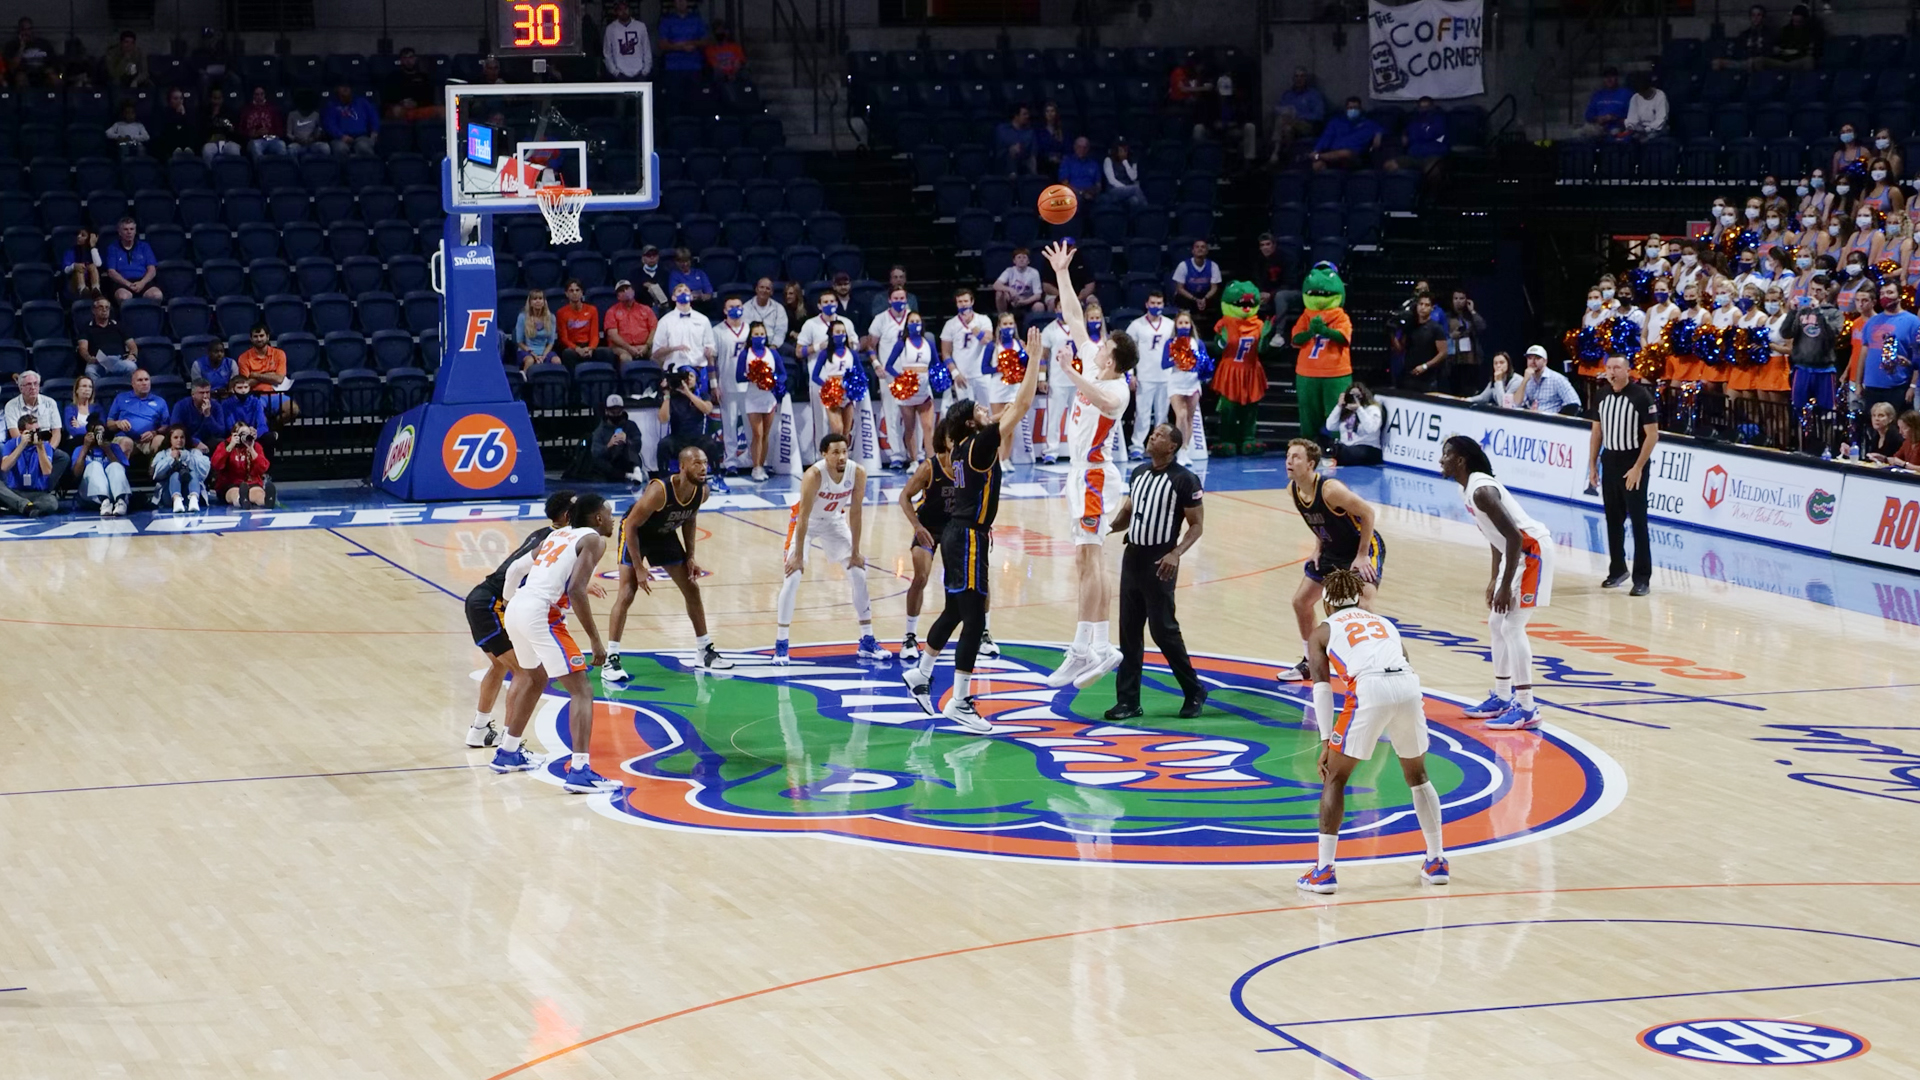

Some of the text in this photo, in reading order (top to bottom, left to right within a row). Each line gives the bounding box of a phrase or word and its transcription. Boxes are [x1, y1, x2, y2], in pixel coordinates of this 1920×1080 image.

[514, 4, 560, 46] 30
[1369, 11, 1395, 29] THE
[1407, 47, 1482, 77] CORNER
[453, 255, 493, 267] SPALDING
[459, 309, 494, 352] F
[1233, 336, 1256, 362] F
[780, 413, 792, 464] FLORIDA
[860, 409, 874, 459] FLORIDA
[452, 428, 508, 473] 76
[952, 459, 966, 488] 31
[1658, 451, 1692, 482] Hill
[824, 501, 839, 512] 0
[534, 540, 568, 568] 24
[1345, 622, 1389, 648] 23
[1654, 1020, 1853, 1064] SEC
